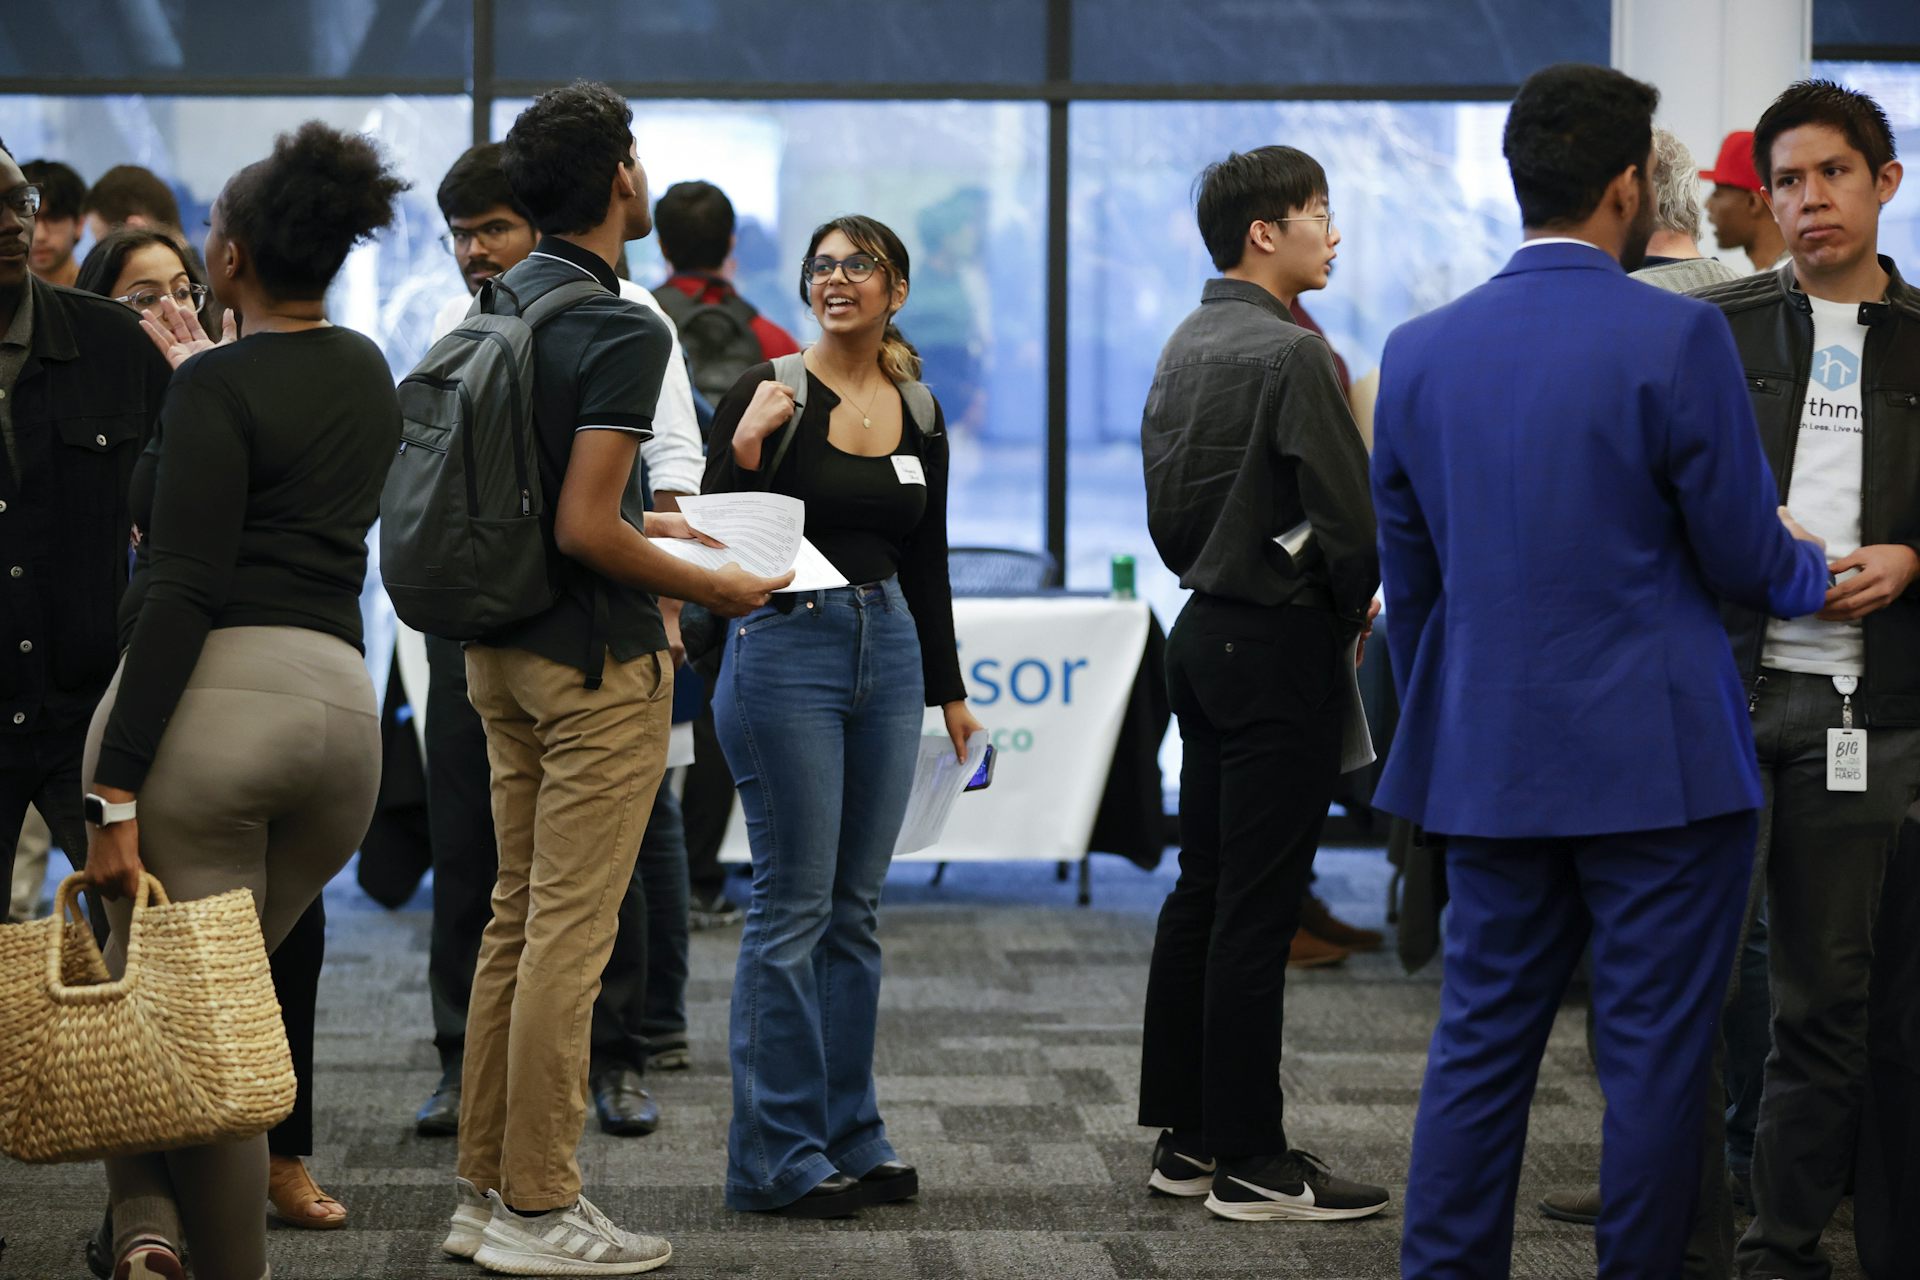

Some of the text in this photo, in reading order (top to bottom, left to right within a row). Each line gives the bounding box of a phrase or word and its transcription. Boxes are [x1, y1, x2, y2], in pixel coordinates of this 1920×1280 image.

[1803, 397, 1863, 420] thm
[955, 639, 1089, 706] sor
[1835, 741, 1858, 757] BIG
[1835, 771, 1862, 780] HARD
